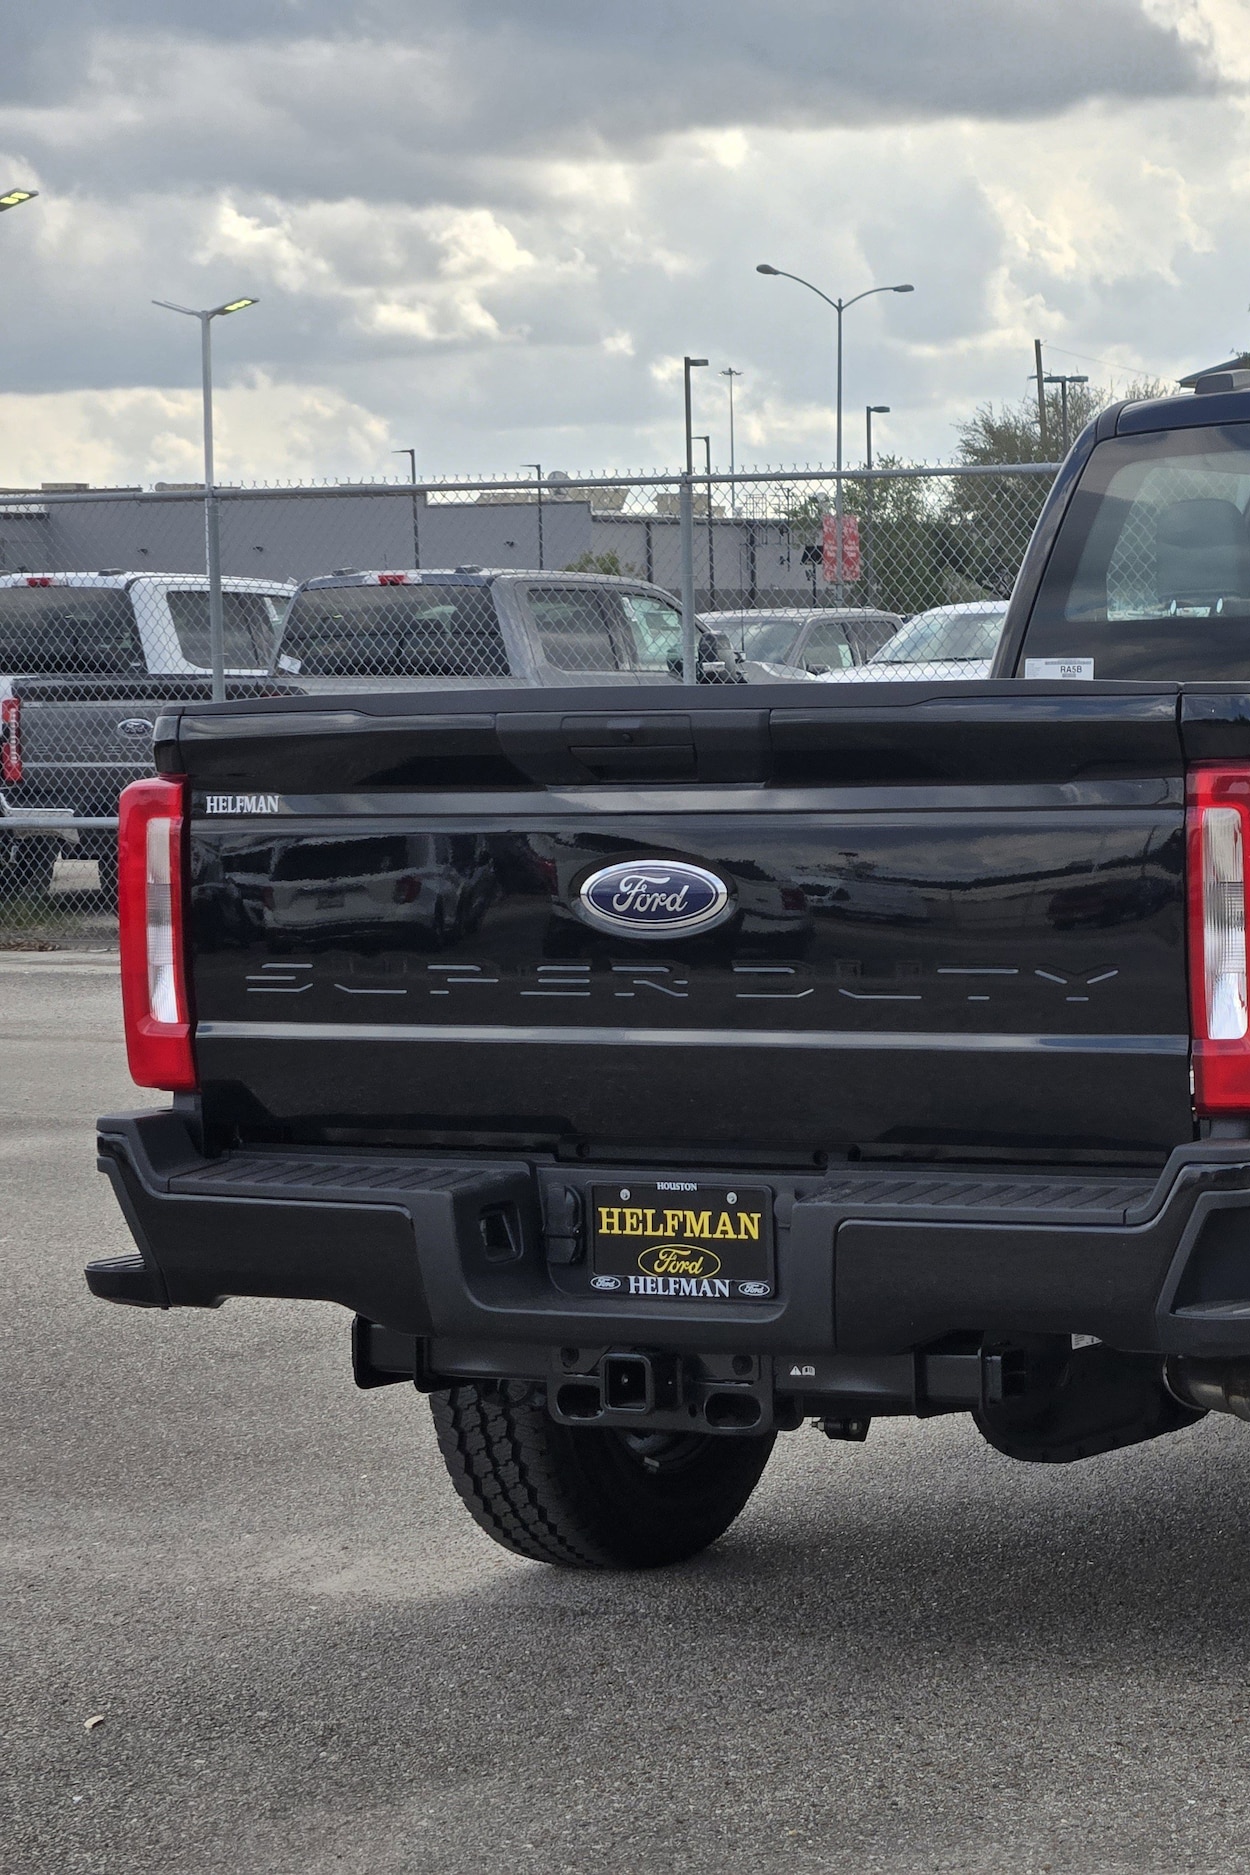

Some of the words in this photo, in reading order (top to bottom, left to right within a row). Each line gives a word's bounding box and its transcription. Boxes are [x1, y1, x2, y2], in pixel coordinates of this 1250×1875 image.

[205, 795, 280, 814] HELFMAN
[612, 874, 690, 912] Ford
[245, 958, 690, 998] SUPER
[731, 961, 1121, 1002] DUTY
[656, 1181, 699, 1192] HOUSTON
[597, 1207, 762, 1240] HELFMAN
[653, 1247, 705, 1275] Ford
[628, 1276, 731, 1298] HELFMAN
